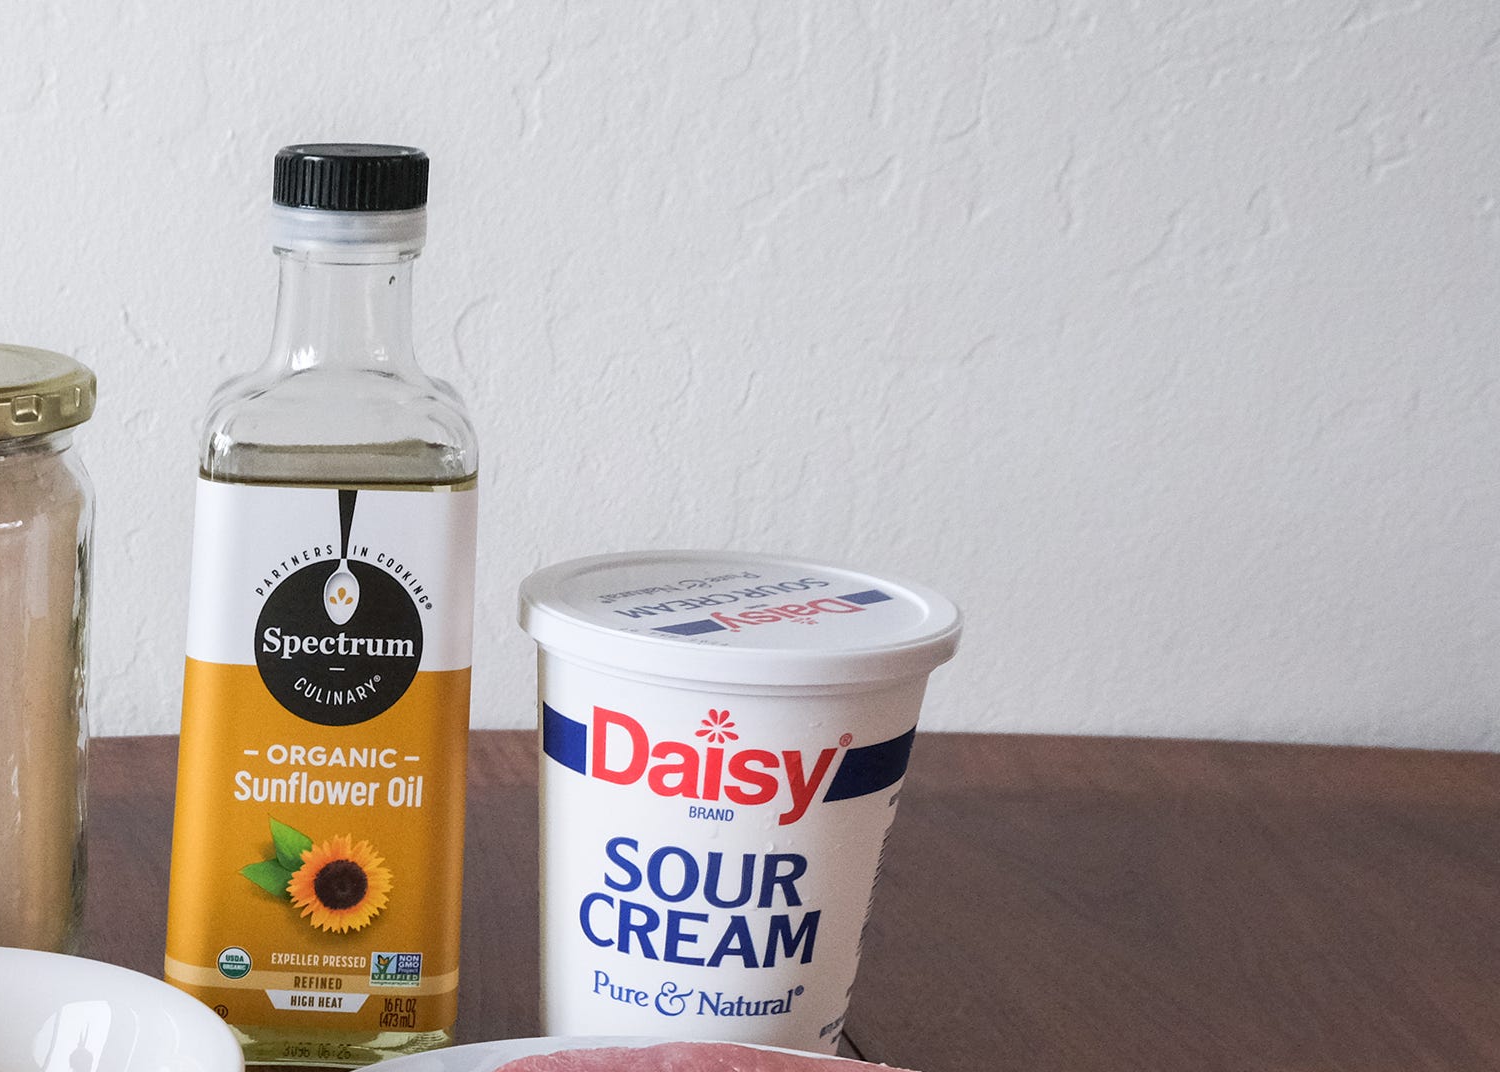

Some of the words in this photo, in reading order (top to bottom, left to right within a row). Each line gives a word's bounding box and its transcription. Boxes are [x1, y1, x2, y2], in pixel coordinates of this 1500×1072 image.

[256, 544, 333, 597] PARTNERS
[353, 545, 368, 557] IN
[738, 577, 830, 598] SOUR
[613, 593, 740, 619] CREAM
[262, 627, 415, 659] Spectrum
[267, 744, 397, 768] ORGANIC
[234, 771, 379, 806] Sunflower
[387, 776, 423, 808] Oil
[688, 805, 734, 822] BRAND
[604, 836, 808, 909] SOUR
[579, 891, 821, 969] CREAM
[225, 954, 244, 962] USDA
[271, 953, 319, 967] EXPELLER
[322, 955, 367, 969] PRESSED
[294, 976, 342, 990] REFINED
[593, 970, 649, 1008] Pure
[654, 981, 694, 1017] &
[290, 996, 314, 1007] HIGH
[318, 997, 343, 1009] HEAT
[384, 998, 393, 1012] 16
[394, 998, 404, 1012] FL
